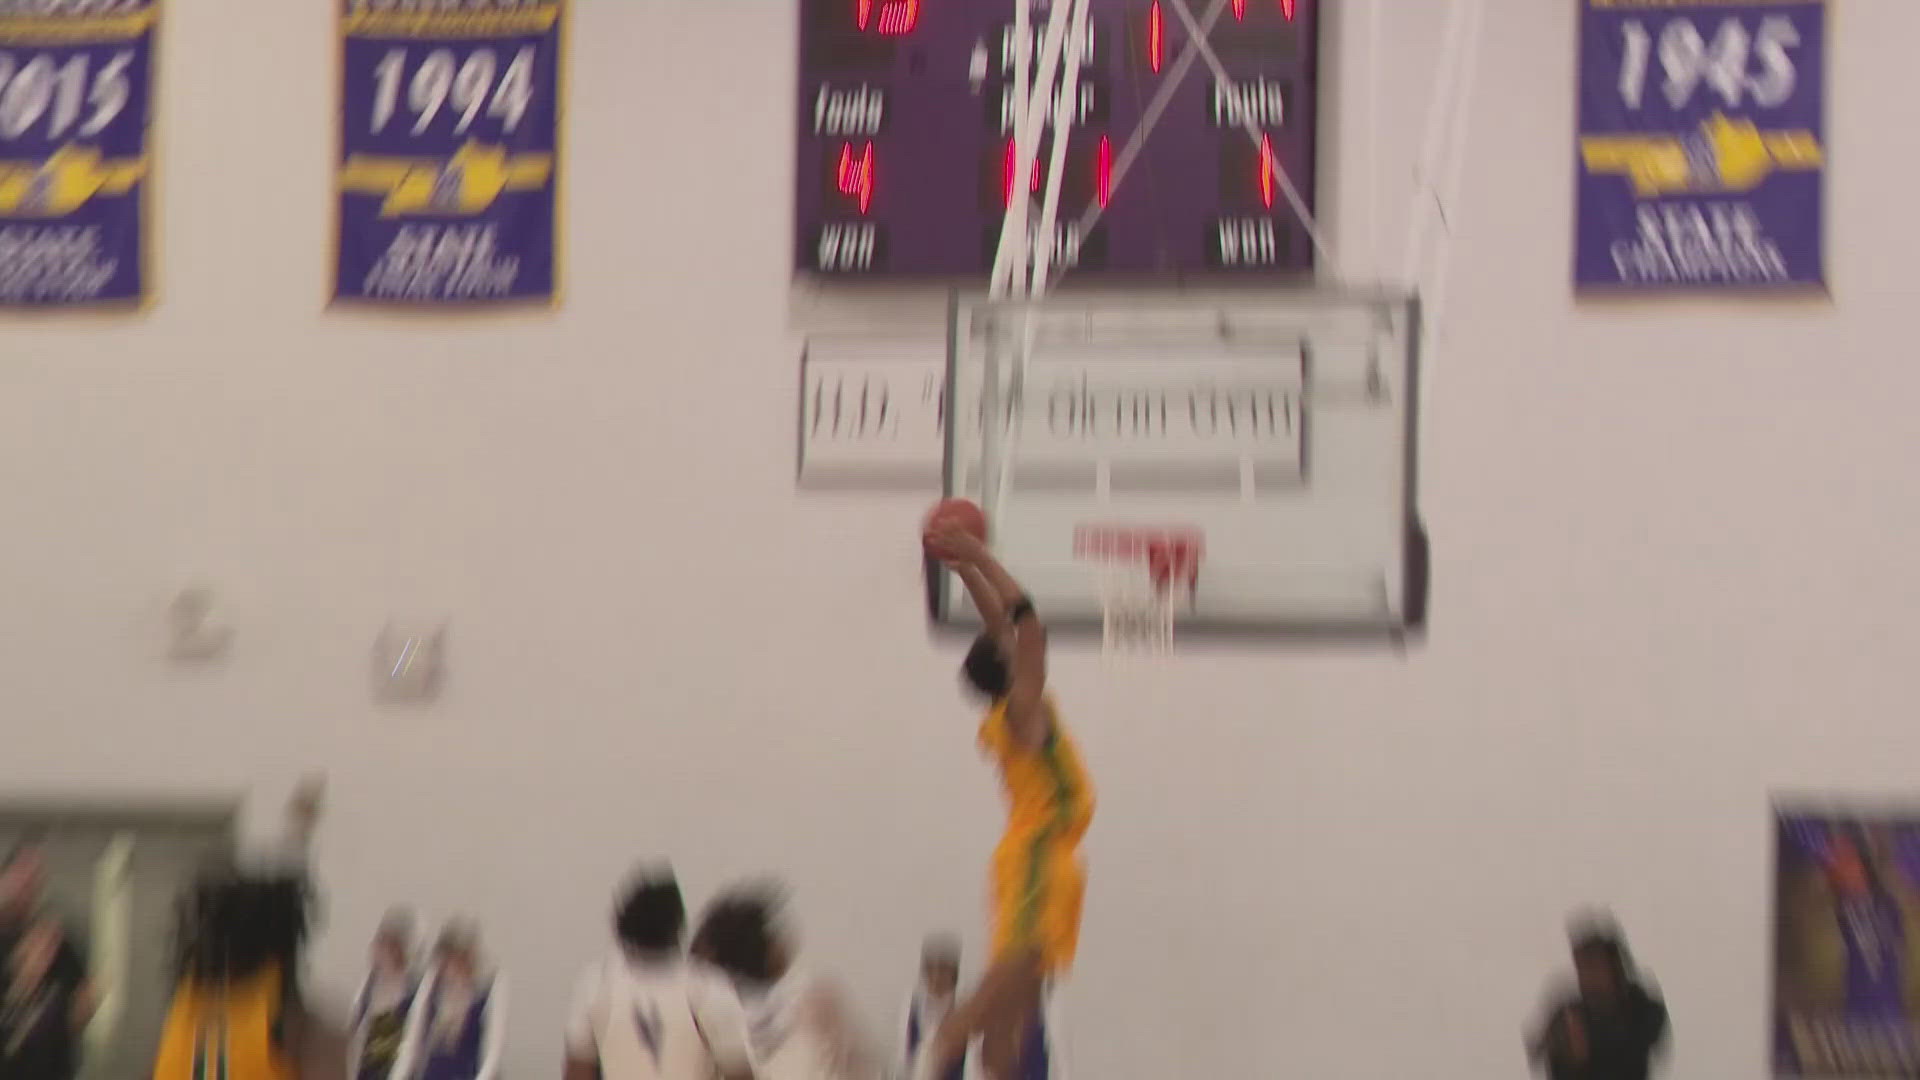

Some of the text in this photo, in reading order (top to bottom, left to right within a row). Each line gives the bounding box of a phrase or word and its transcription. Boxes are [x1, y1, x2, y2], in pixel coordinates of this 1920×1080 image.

[0, 50, 135, 142] 015
[370, 45, 535, 136] 1994
[1617, 15, 1800, 109] 1945
